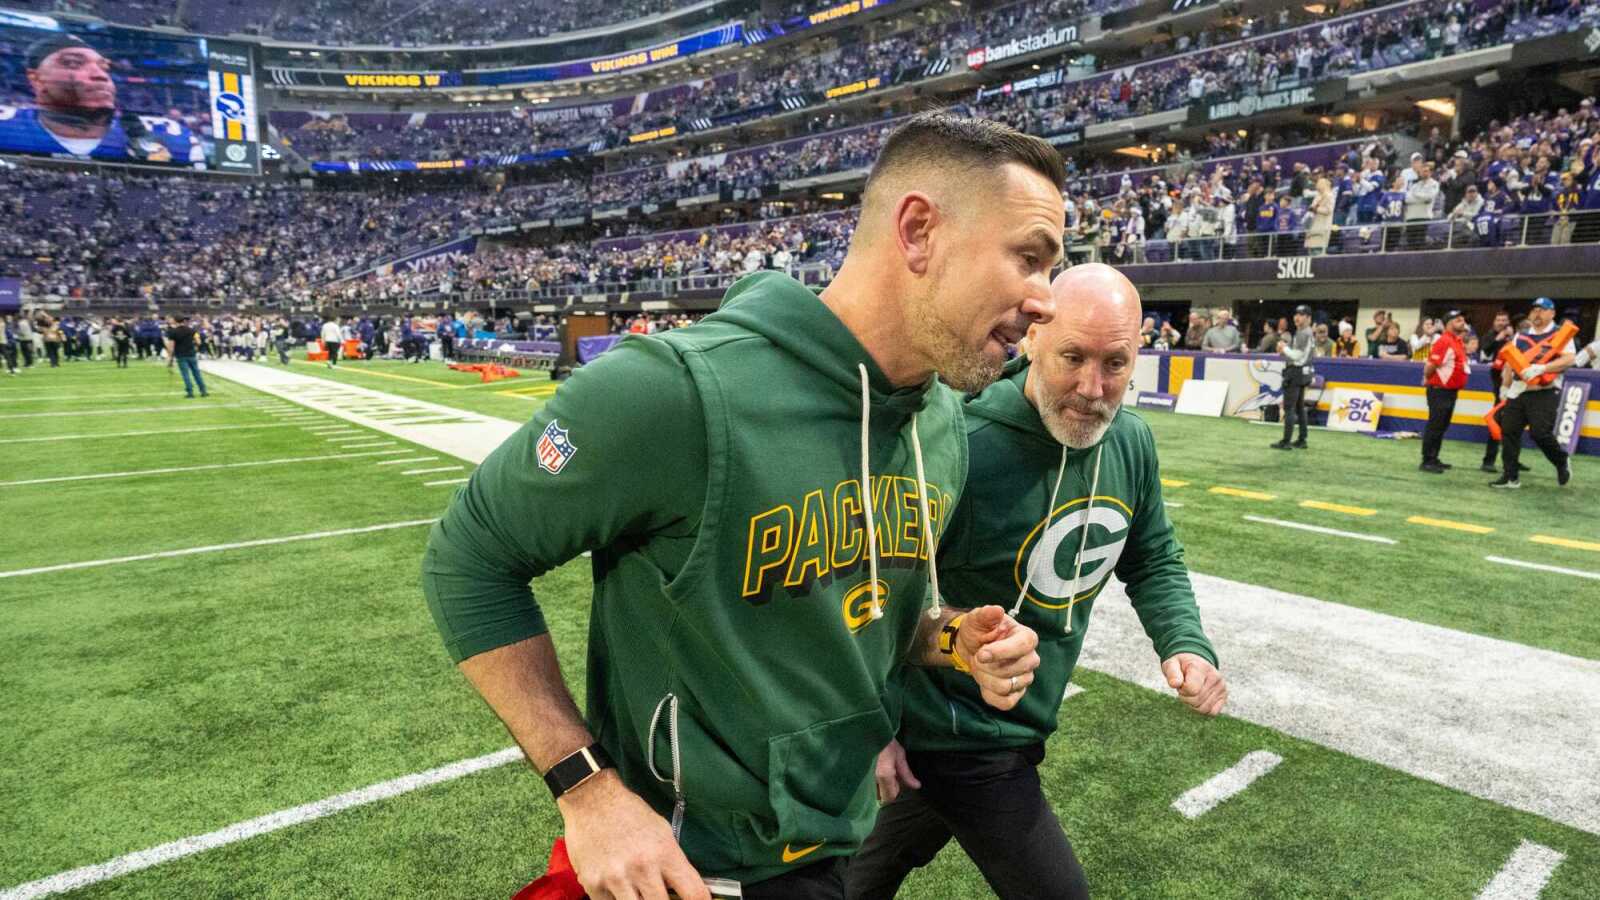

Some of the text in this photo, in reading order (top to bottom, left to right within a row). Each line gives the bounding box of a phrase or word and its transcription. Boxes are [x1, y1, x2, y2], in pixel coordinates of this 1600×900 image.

[809, 1, 860, 24] VIKINGS
[591, 53, 648, 72] VIKINGS
[345, 74, 421, 87] VIKINGS
[1277, 256, 1315, 279] SKOL
[1349, 397, 1374, 411] SK
[1348, 410, 1373, 424] OL
[538, 435, 561, 470] NFL
[742, 476, 953, 598] PACKER
[1026, 506, 1129, 600] G
[843, 580, 889, 631] G
